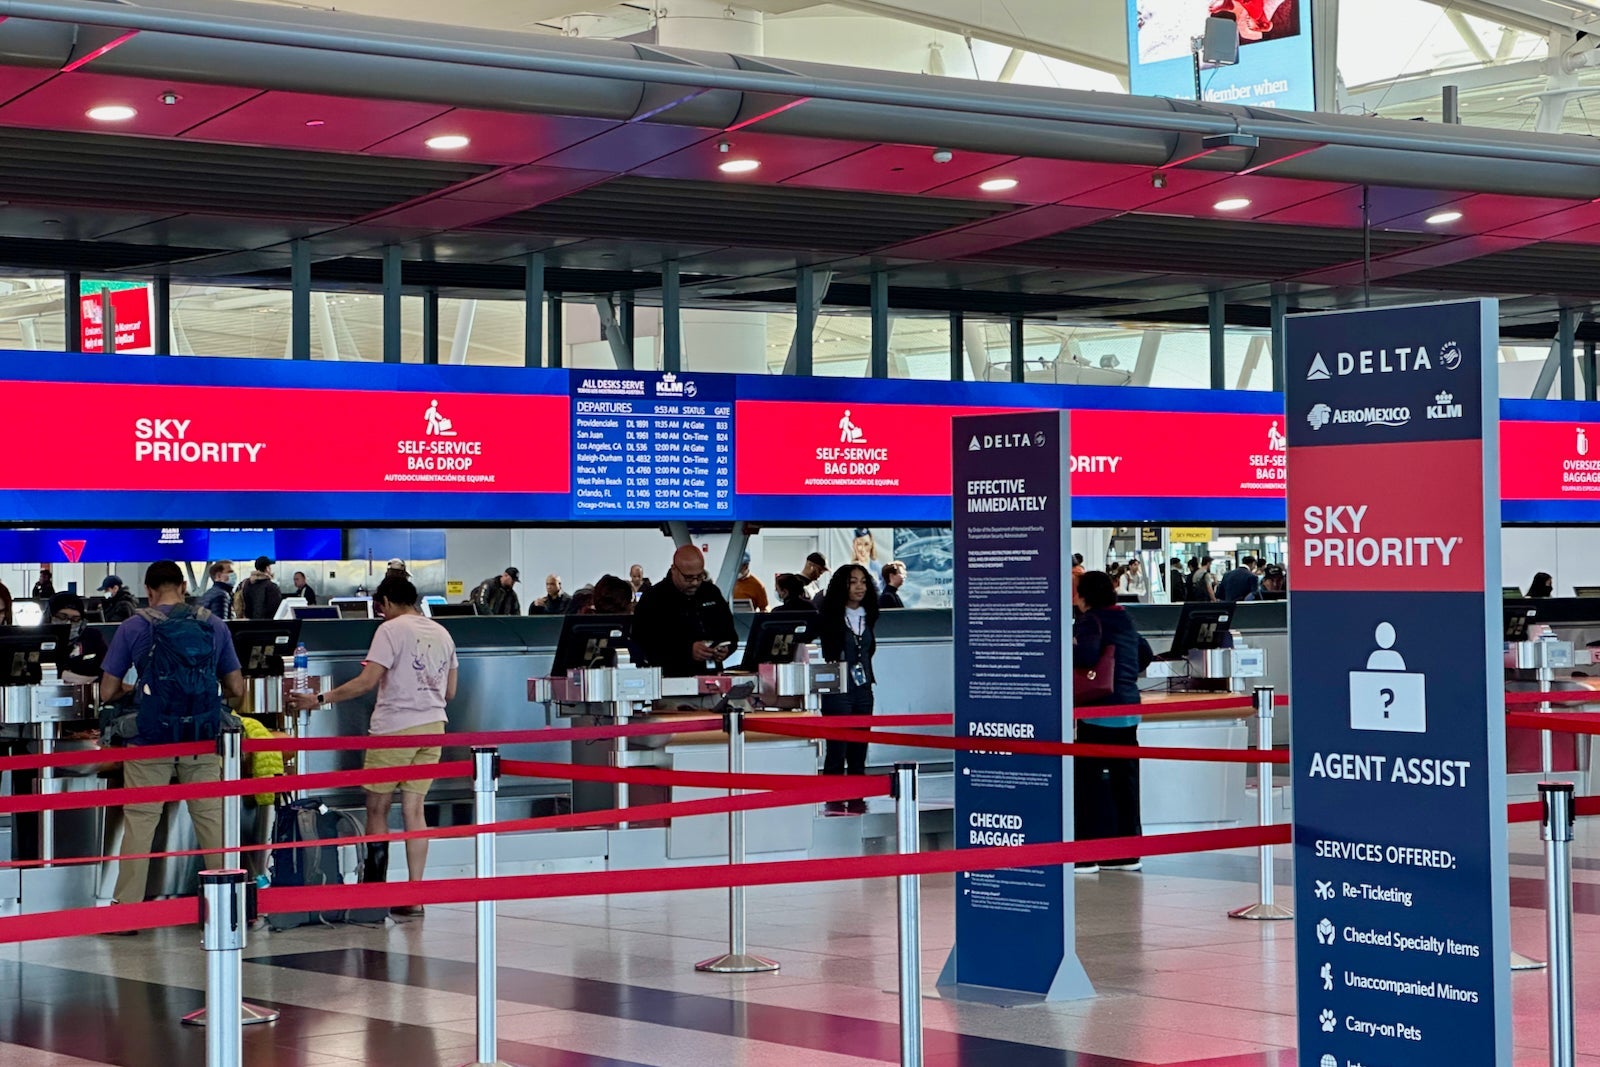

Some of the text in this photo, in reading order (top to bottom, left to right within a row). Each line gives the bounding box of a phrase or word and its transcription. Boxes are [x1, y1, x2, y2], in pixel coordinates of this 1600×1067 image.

[1254, 80, 1288, 96] when
[1338, 346, 1432, 375] DELTA
[582, 379, 683, 392] ALL DESKS SERVE KLM
[577, 402, 730, 416] DEPARTURES 9:53 AM STATUS GATE
[1427, 404, 1462, 419] KLM
[135, 418, 191, 439] SKY
[577, 419, 618, 427] Providenciales
[626, 420, 635, 428] DL
[669, 420, 679, 428] AM
[683, 421, 690, 429] At
[691, 421, 704, 429] Gate
[716, 422, 728, 430] B33
[590, 431, 603, 439] Juan
[626, 431, 635, 439] DL
[669, 432, 679, 440] AM
[683, 433, 708, 441] On-Time
[716, 433, 728, 441] B24
[984, 434, 1031, 448] DELTA
[398, 441, 481, 454] SELF-SERVICE
[588, 442, 612, 452] Angeles,
[626, 443, 635, 451] DL
[636, 443, 647, 451] 536
[669, 444, 679, 452] PM
[691, 445, 704, 453] Gate
[716, 445, 728, 453] B34
[816, 448, 888, 460] SELF-SERVICE
[408, 456, 472, 470] BAG DROP
[577, 454, 622, 464] Raleigh-Durham
[626, 455, 635, 463] DL
[669, 456, 679, 464] PM
[683, 456, 708, 464] On-Time
[716, 457, 728, 465] A21
[577, 466, 596, 476] Ithaca,
[626, 467, 635, 475] DL
[669, 467, 679, 475] PM
[683, 468, 708, 476] On-Time
[716, 468, 728, 476] A10
[825, 463, 880, 474] BAG DROP
[1256, 468, 1275, 479] BAG
[577, 477, 591, 485] West
[592, 478, 605, 486] Palm
[606, 478, 622, 486] Beach
[626, 478, 635, 486] DL
[669, 478, 679, 486] PM
[683, 479, 690, 487] At
[691, 479, 704, 487] Gate
[716, 479, 728, 487] B20
[968, 479, 1025, 495] EFFECTIVE
[577, 489, 603, 499] Orlando,
[626, 490, 635, 498] DL
[669, 490, 679, 498] PM
[683, 490, 708, 498] On-Time
[716, 491, 728, 499] B27
[626, 502, 635, 510] DL
[669, 502, 679, 510] PM
[683, 502, 708, 510] On-Time
[716, 502, 728, 510] B53
[968, 496, 1047, 512] IMMEDIATELY
[1304, 505, 1367, 535] SKY
[969, 722, 1034, 738] PASSENGER
[1309, 752, 1470, 787] AGENT ASSIST
[970, 813, 1022, 829] CHECKED
[1315, 840, 1456, 869] SERVICES OFFERED:
[1342, 882, 1412, 906] Re-Ticketing
[1343, 927, 1479, 957] Checked Specialty Items
[1345, 971, 1478, 1003] Unaccompanied Minors
[1346, 1016, 1421, 1040] Carry-on Pets
